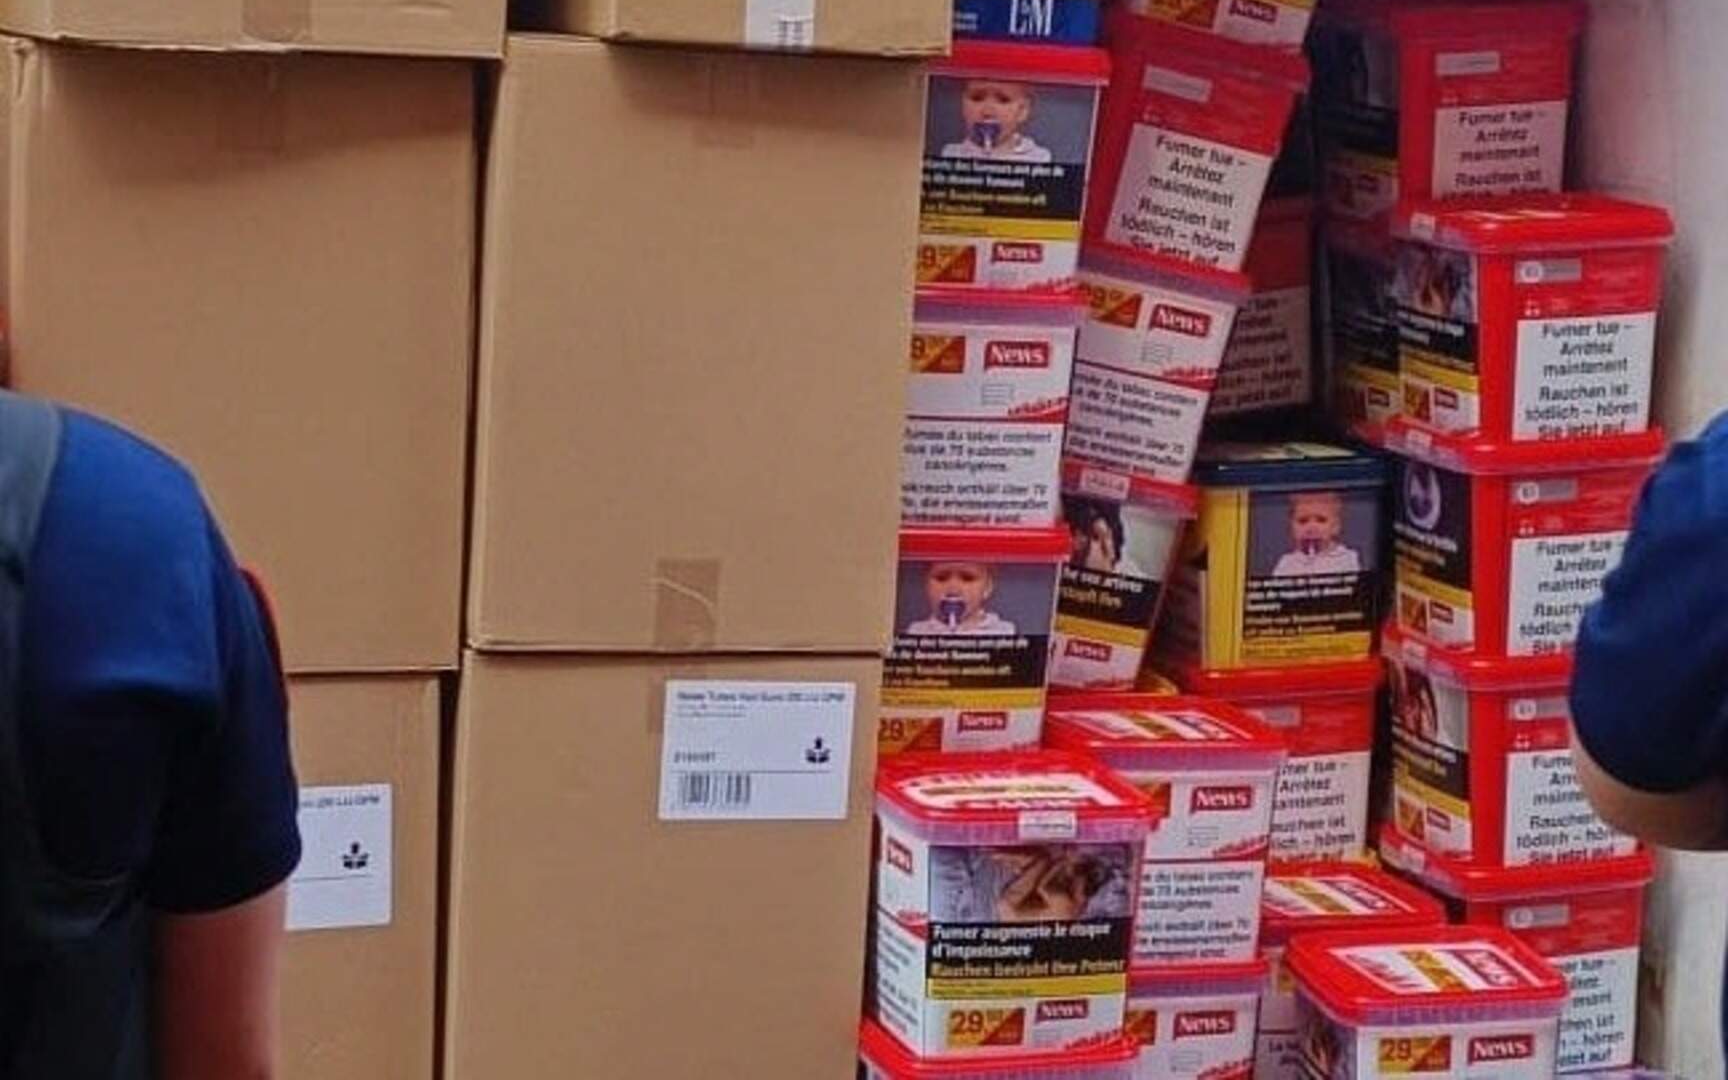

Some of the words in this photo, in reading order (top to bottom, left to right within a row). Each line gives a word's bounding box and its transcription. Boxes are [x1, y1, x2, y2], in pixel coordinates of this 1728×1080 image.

[1156, 134, 1206, 159] Fumer
[1542, 322, 1591, 339] Fumer
[990, 343, 1045, 365] News
[1538, 385, 1606, 401] Rauchen
[1537, 540, 1586, 556] Fumer
[1195, 789, 1248, 808] News
[932, 924, 979, 940] Fumer
[981, 924, 1051, 943] augmente
[1054, 923, 1067, 937] le
[1069, 922, 1112, 938] risque
[932, 942, 1033, 959] d'impuissance
[931, 961, 992, 978] Rauchen
[950, 1009, 985, 1034] 29
[1041, 1001, 1086, 1019] News
[1178, 1014, 1232, 1033] News
[1382, 1038, 1413, 1060] 29
[1471, 1037, 1530, 1060] News
